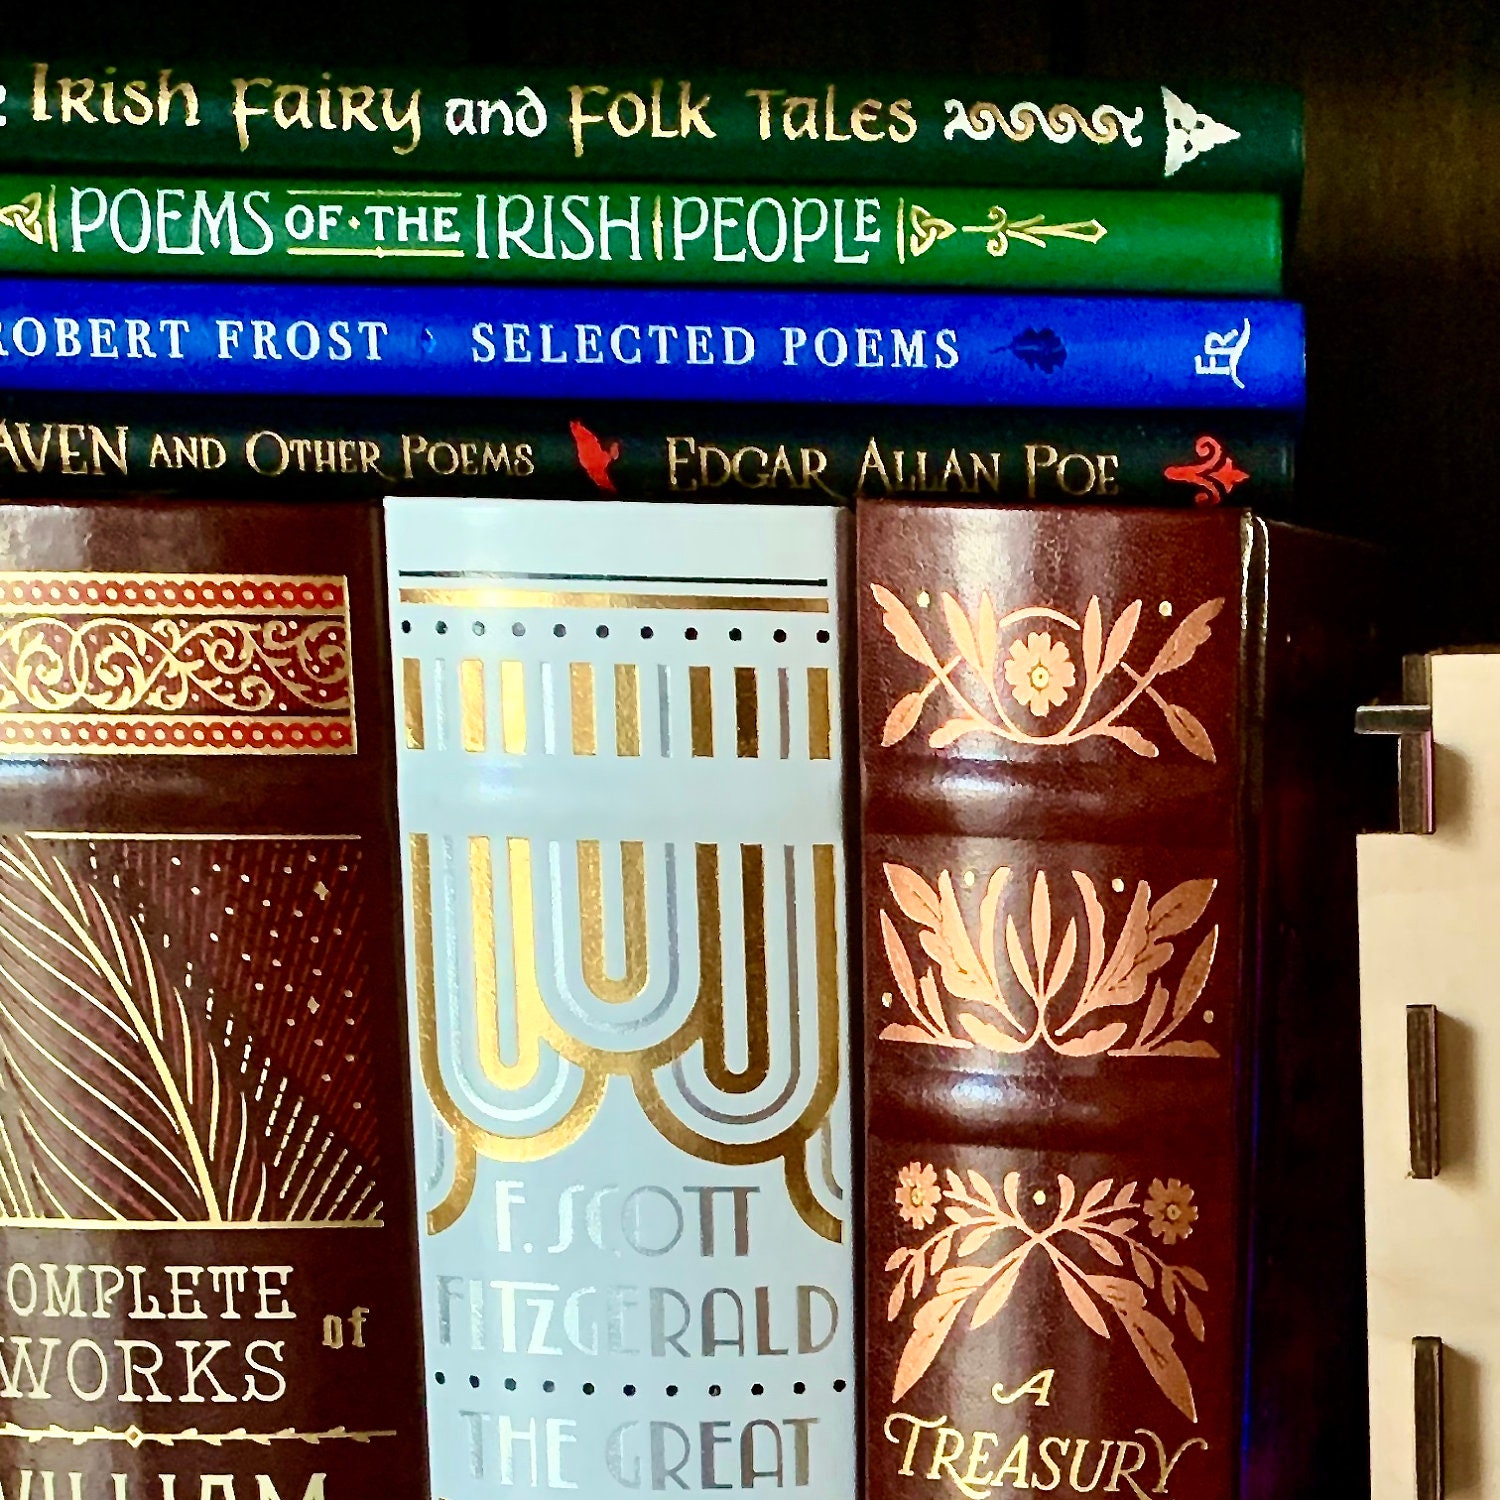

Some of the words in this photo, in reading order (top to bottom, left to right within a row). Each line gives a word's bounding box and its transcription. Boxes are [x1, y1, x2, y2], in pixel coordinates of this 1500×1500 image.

[32, 62, 198, 127] Irish
[231, 72, 420, 155] Fairy
[445, 87, 547, 137] and
[567, 79, 716, 157] Folk
[745, 86, 918, 143] Tales
[70, 186, 273, 256] POEMS
[285, 204, 341, 242] OF
[373, 205, 460, 243] THE
[476, 194, 642, 261] IRISH
[673, 196, 880, 264] PEOPLE
[0, 316, 190, 359] OBERT
[216, 319, 389, 361] FROST
[472, 323, 756, 366] SELECTED
[781, 327, 960, 368] POEMS
[495, 1180, 534, 1253] F.
[548, 1183, 761, 1257] SCOTT
[322, 1306, 369, 1349] of
[436, 1274, 840, 1357] FITZGERALD
[0, 1337, 286, 1402] WORKS
[992, 1369, 1055, 1406] A
[459, 1411, 579, 1490] THE
[605, 1416, 822, 1490] GREAT
